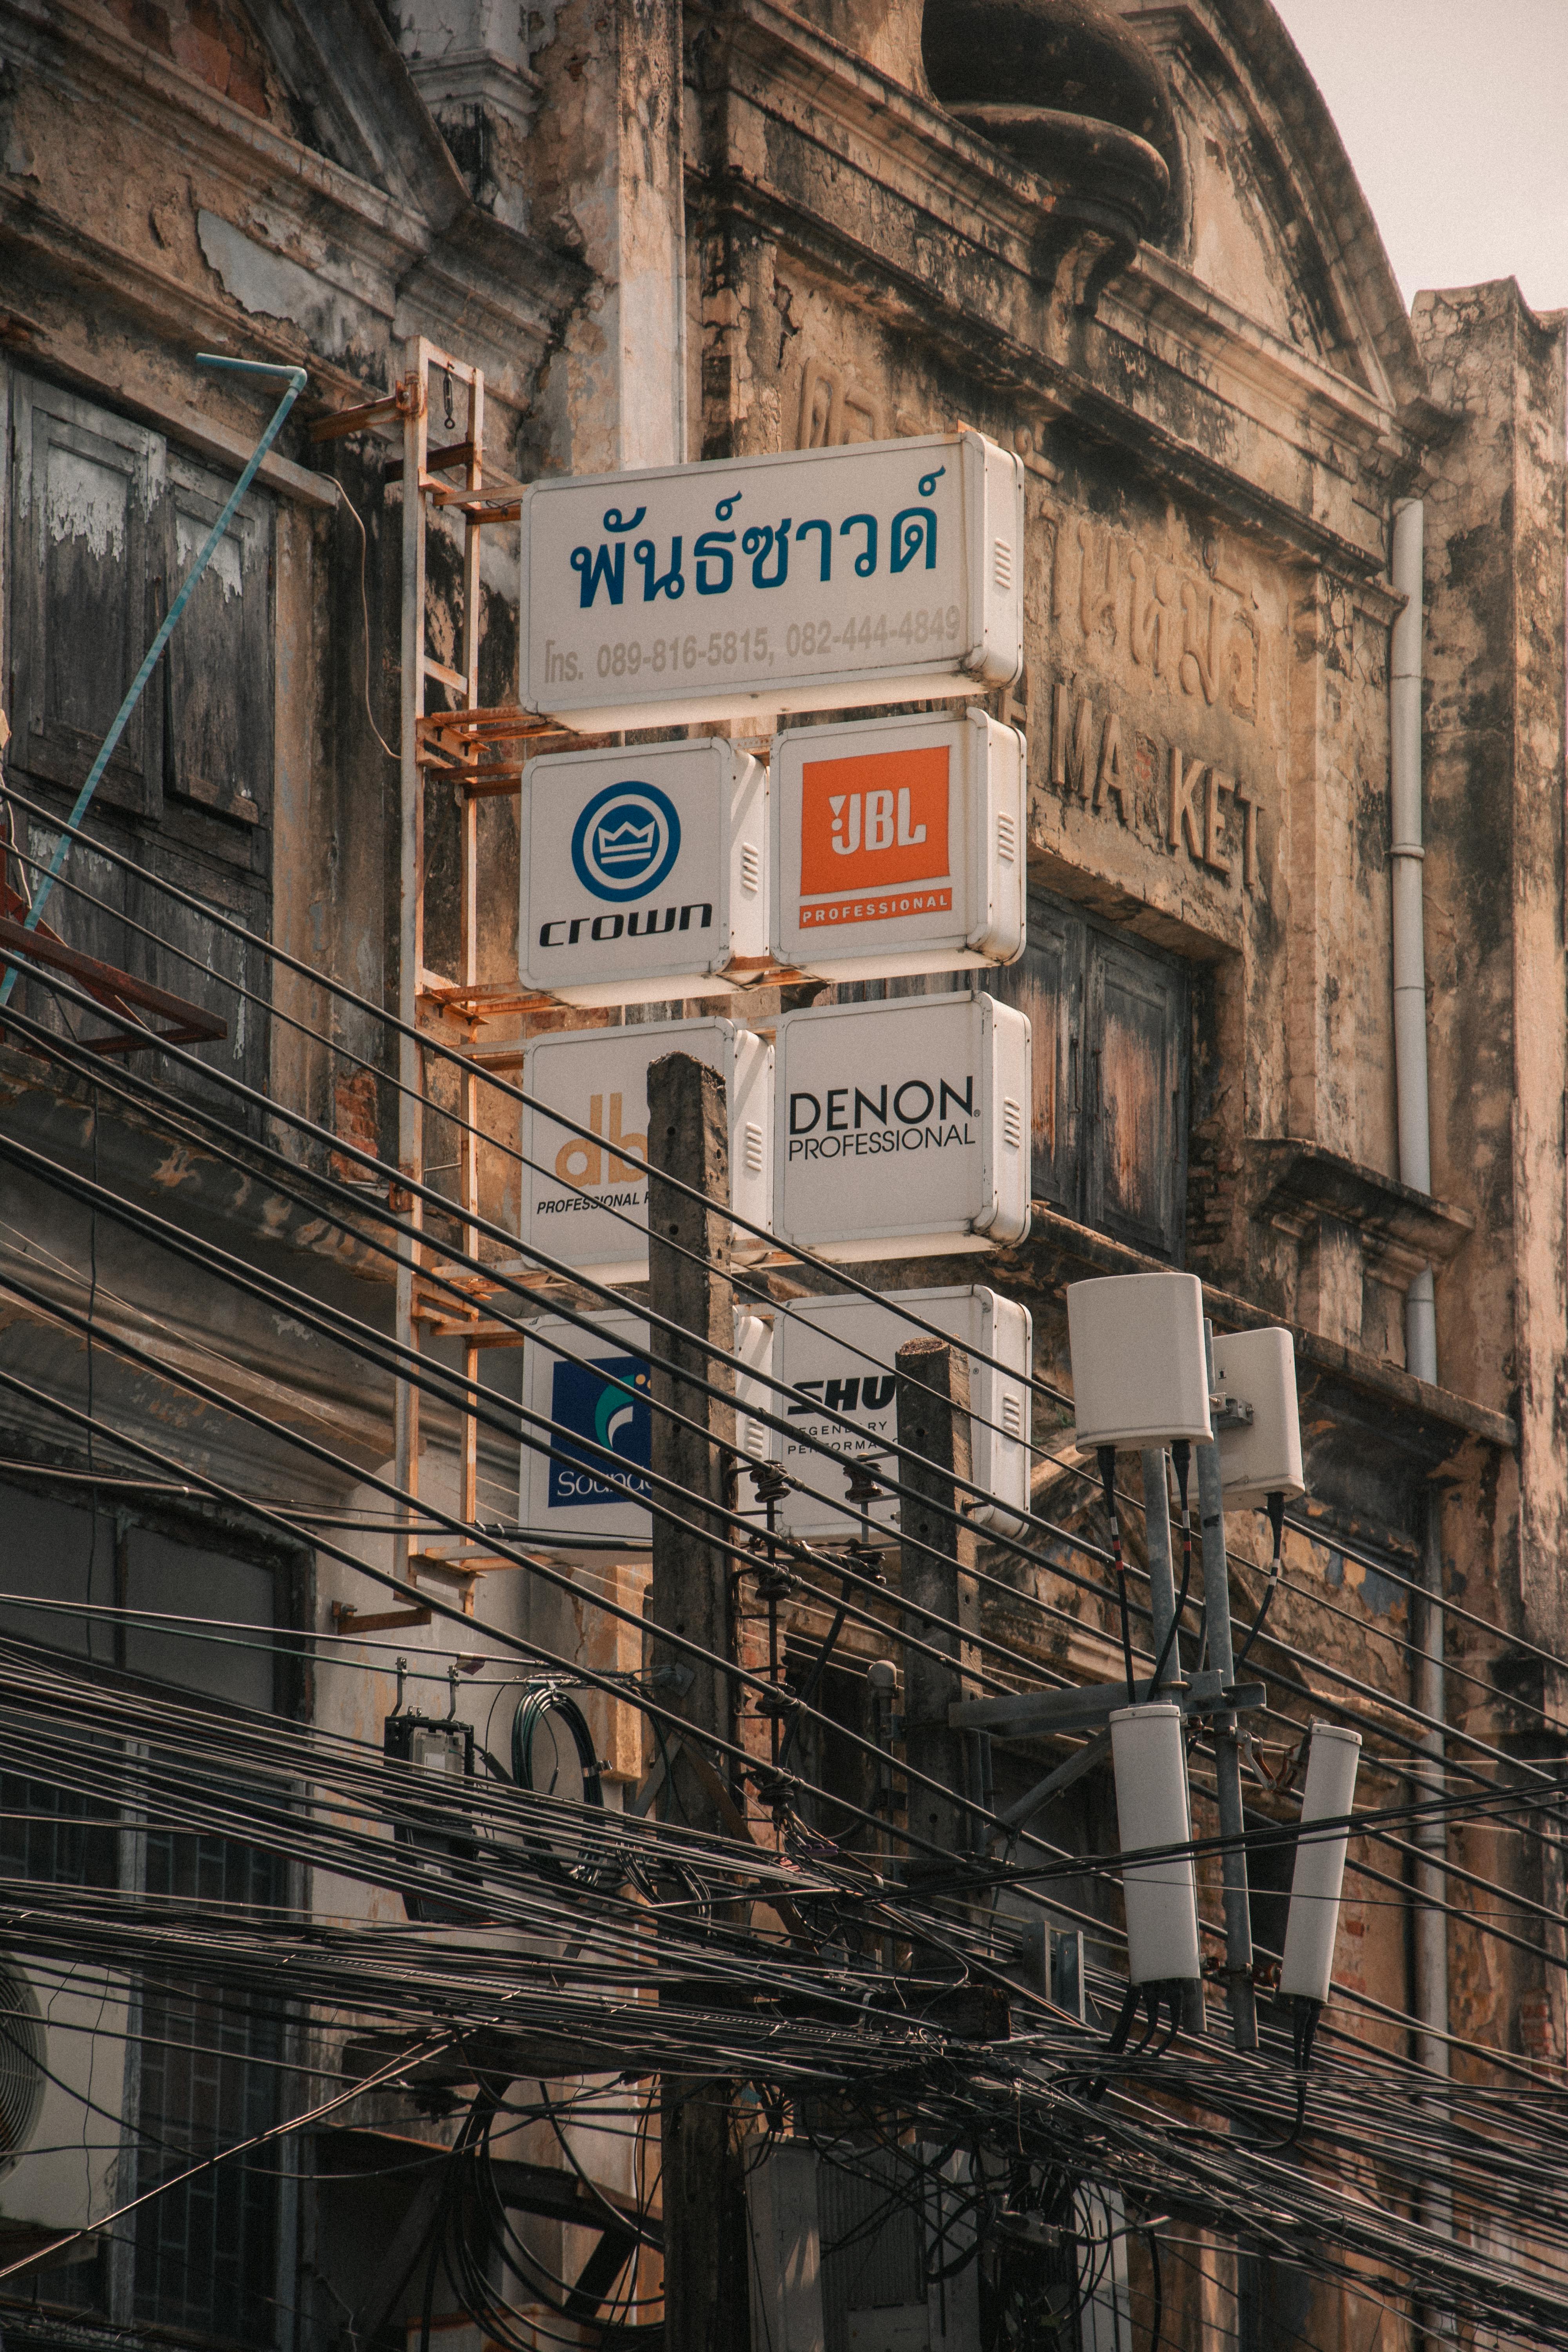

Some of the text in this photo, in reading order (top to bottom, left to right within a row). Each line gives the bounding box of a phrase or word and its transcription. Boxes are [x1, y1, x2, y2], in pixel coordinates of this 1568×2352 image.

[570, 465, 946, 608] พันธ์ซาวด์
[597, 627, 775, 678] 089-816-5815,
[786, 605, 960, 657] 082-444-4849
[1051, 683, 1265, 889] MAKET
[828, 787, 926, 856] JBL
[539, 903, 713, 947] crown
[803, 894, 948, 923] PROFESSIONAL
[555, 1092, 648, 1188] db
[789, 1123, 976, 1161] PROFESSIONAL
[537, 1192, 640, 1215] PROFESSIONAL
[787, 1375, 896, 1415] SHU
